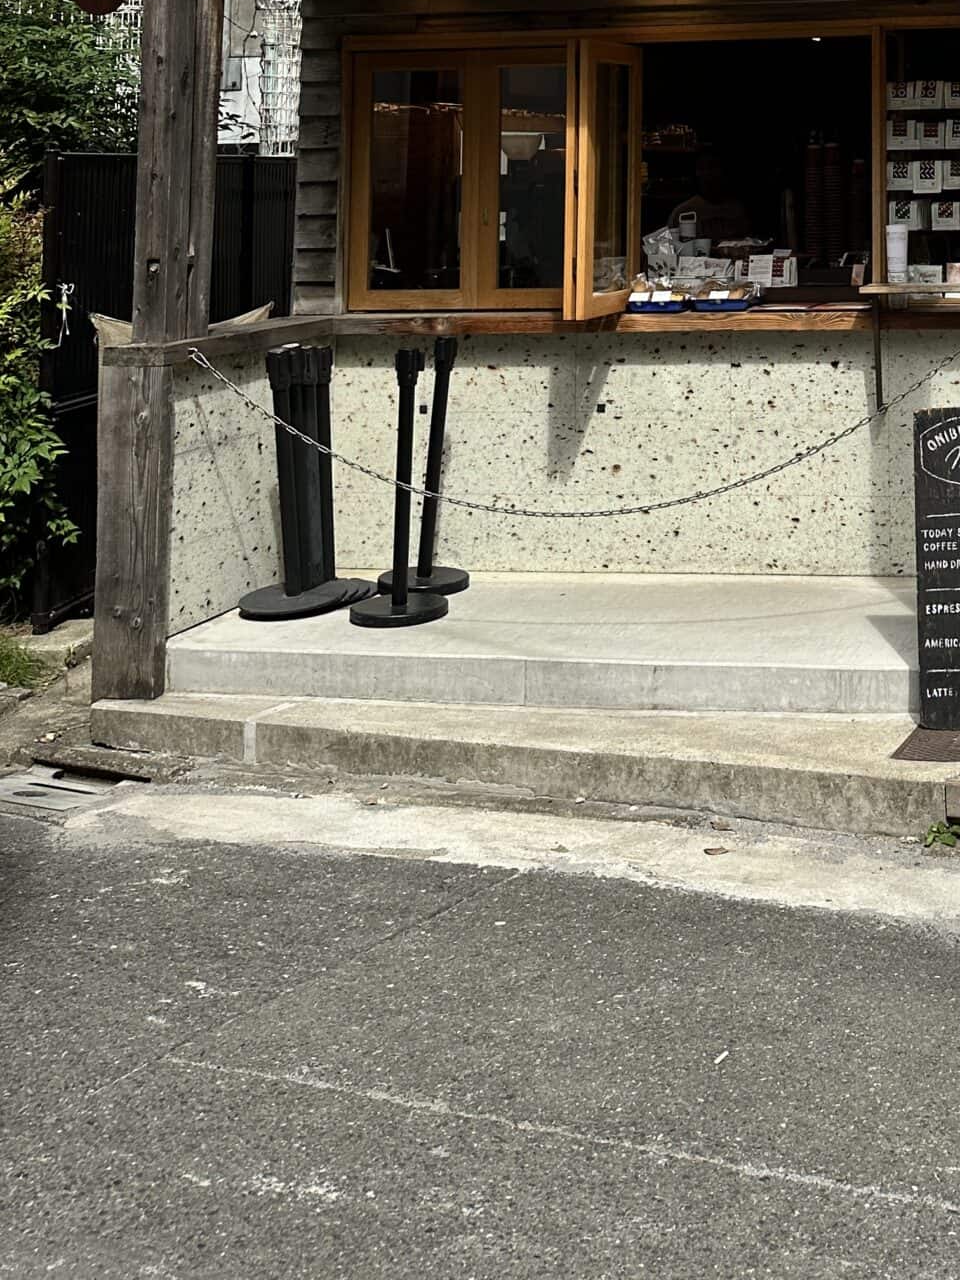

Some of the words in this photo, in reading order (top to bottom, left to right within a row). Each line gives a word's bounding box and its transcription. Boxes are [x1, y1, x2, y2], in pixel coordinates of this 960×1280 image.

[923, 542, 958, 552] COFFEE
[924, 560, 949, 570] HAND
[926, 688, 953, 698] LATTE
